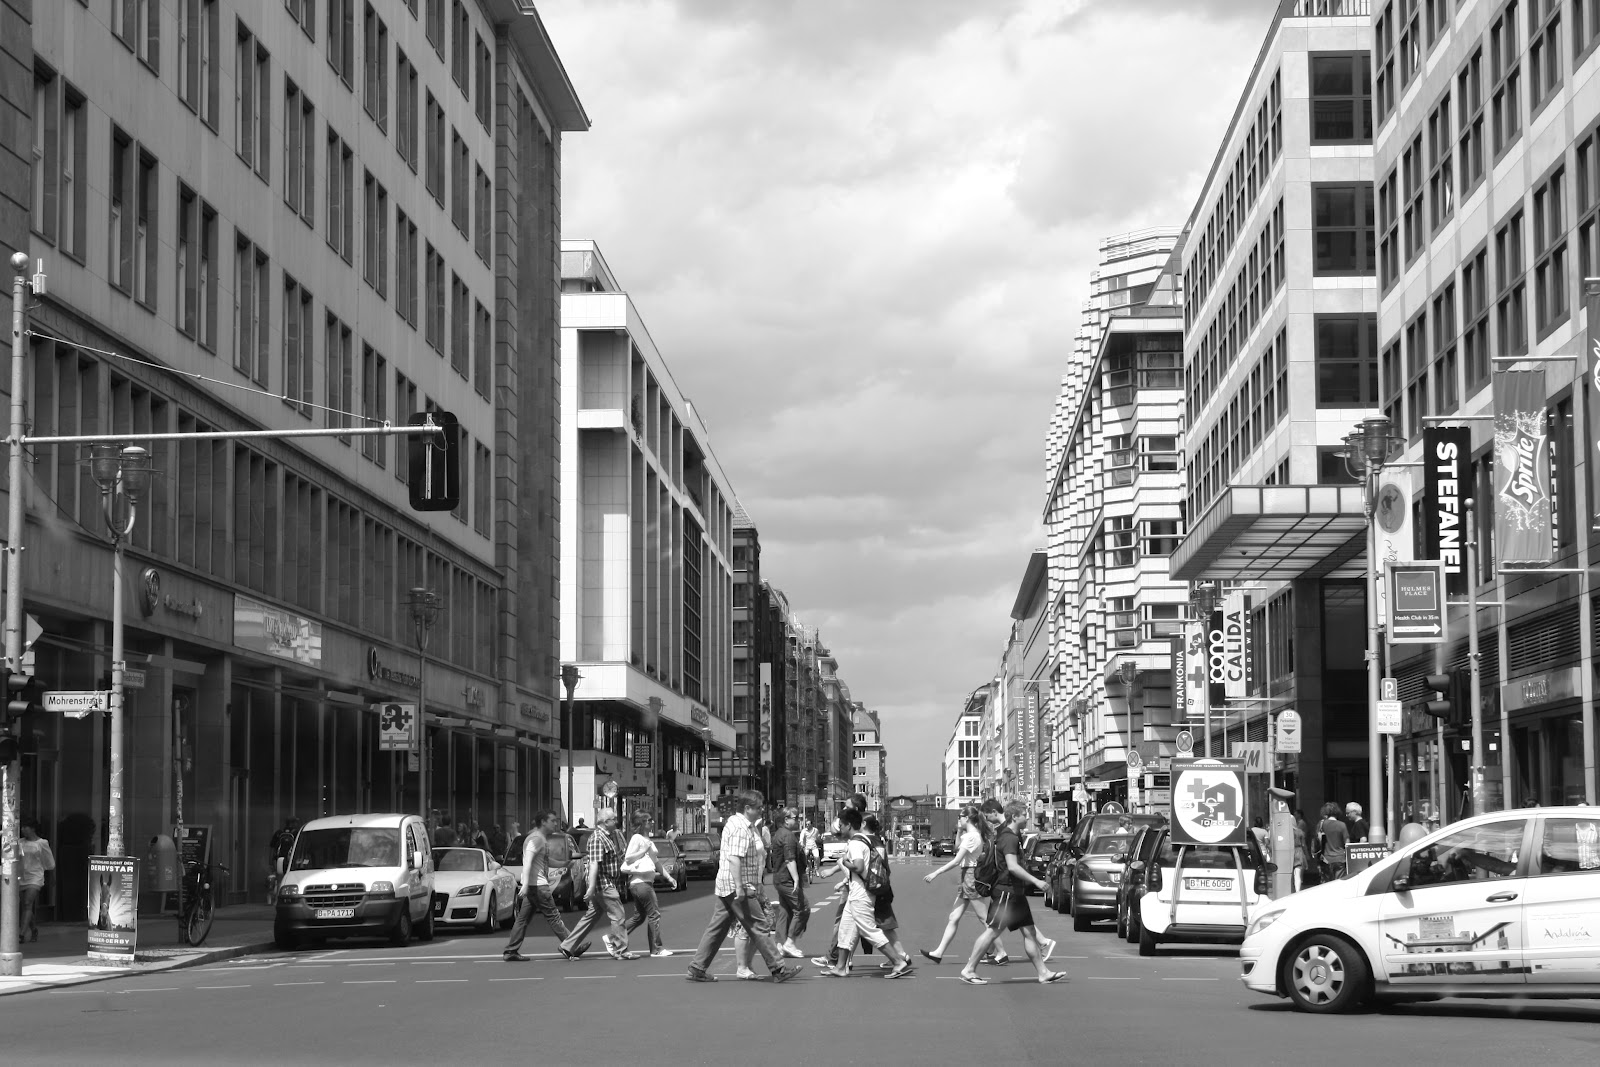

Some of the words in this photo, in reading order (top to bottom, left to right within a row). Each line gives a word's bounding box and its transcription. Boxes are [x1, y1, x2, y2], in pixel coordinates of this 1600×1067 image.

[1511, 437, 1538, 504] Sprite
[1227, 611, 1242, 682] CALIDA
[1176, 651, 1184, 709] FRANKONIA
[1278, 801, 1285, 811] P
